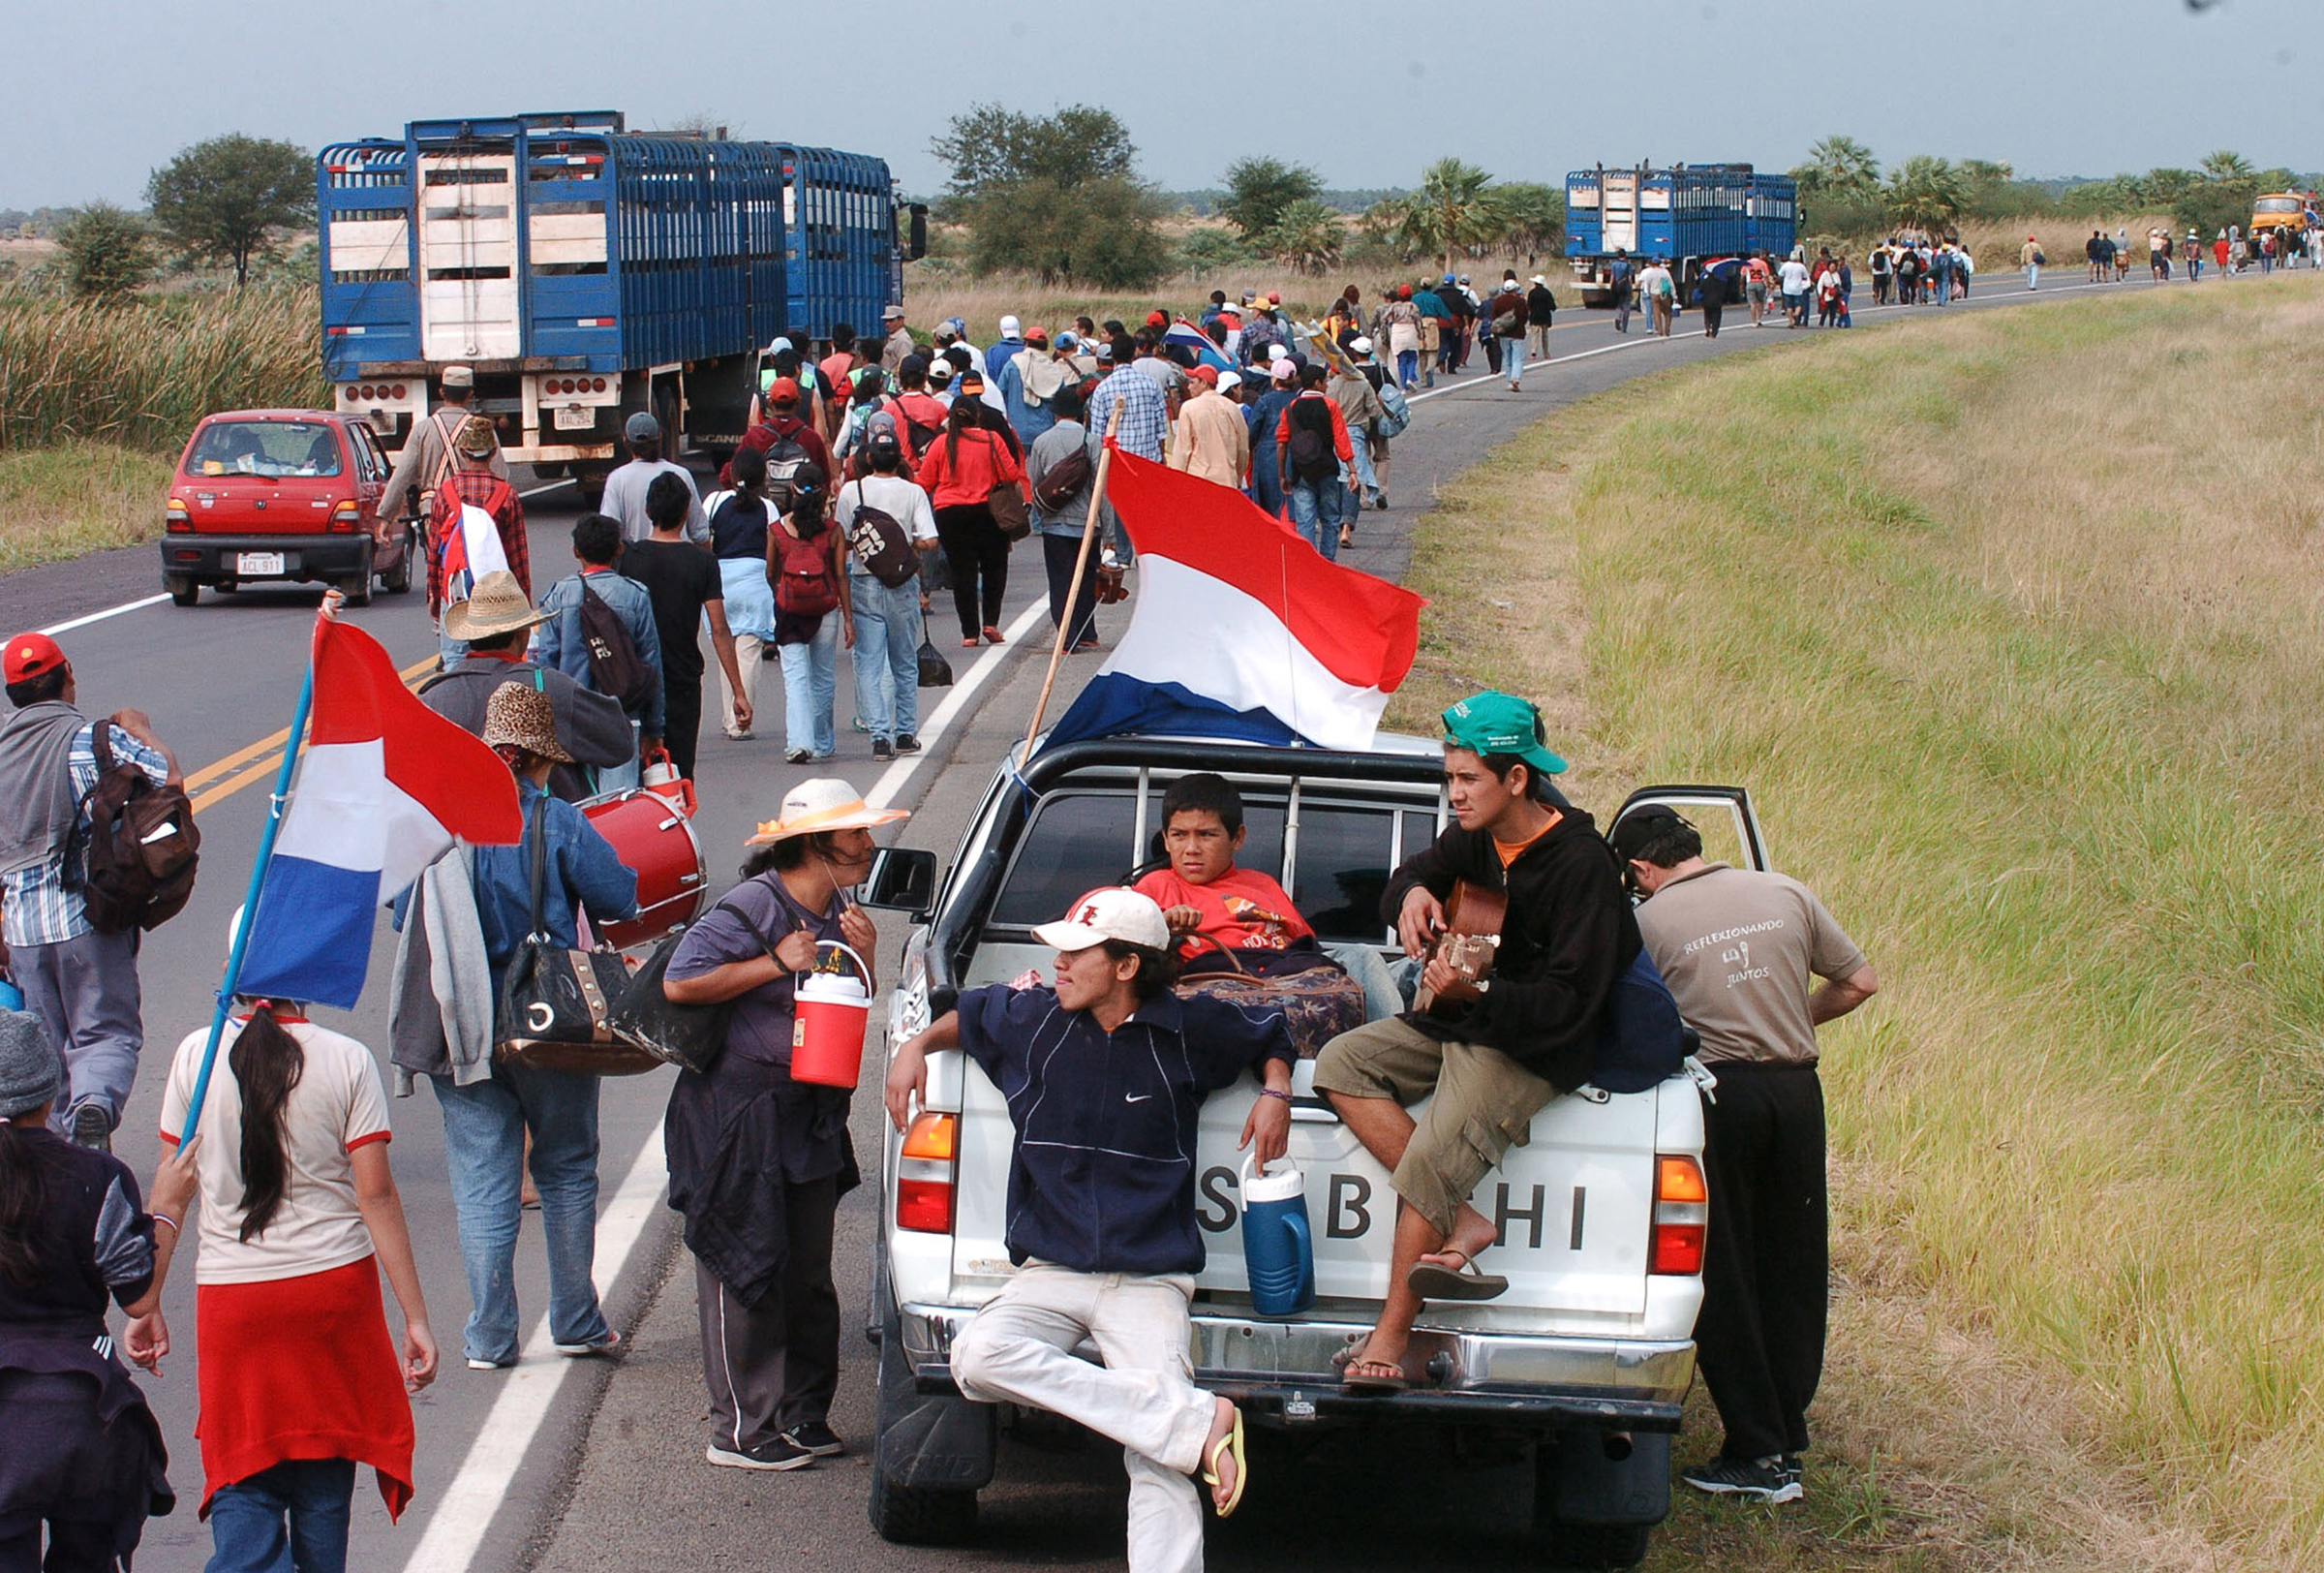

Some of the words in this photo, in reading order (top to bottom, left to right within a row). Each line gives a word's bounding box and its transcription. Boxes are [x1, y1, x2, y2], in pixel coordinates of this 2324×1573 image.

[242, 561, 259, 572] ACL
[262, 561, 280, 572] 911
[1684, 919, 1785, 955] REFLEXIONANDO
[1726, 967, 1769, 989] JUNTOS
